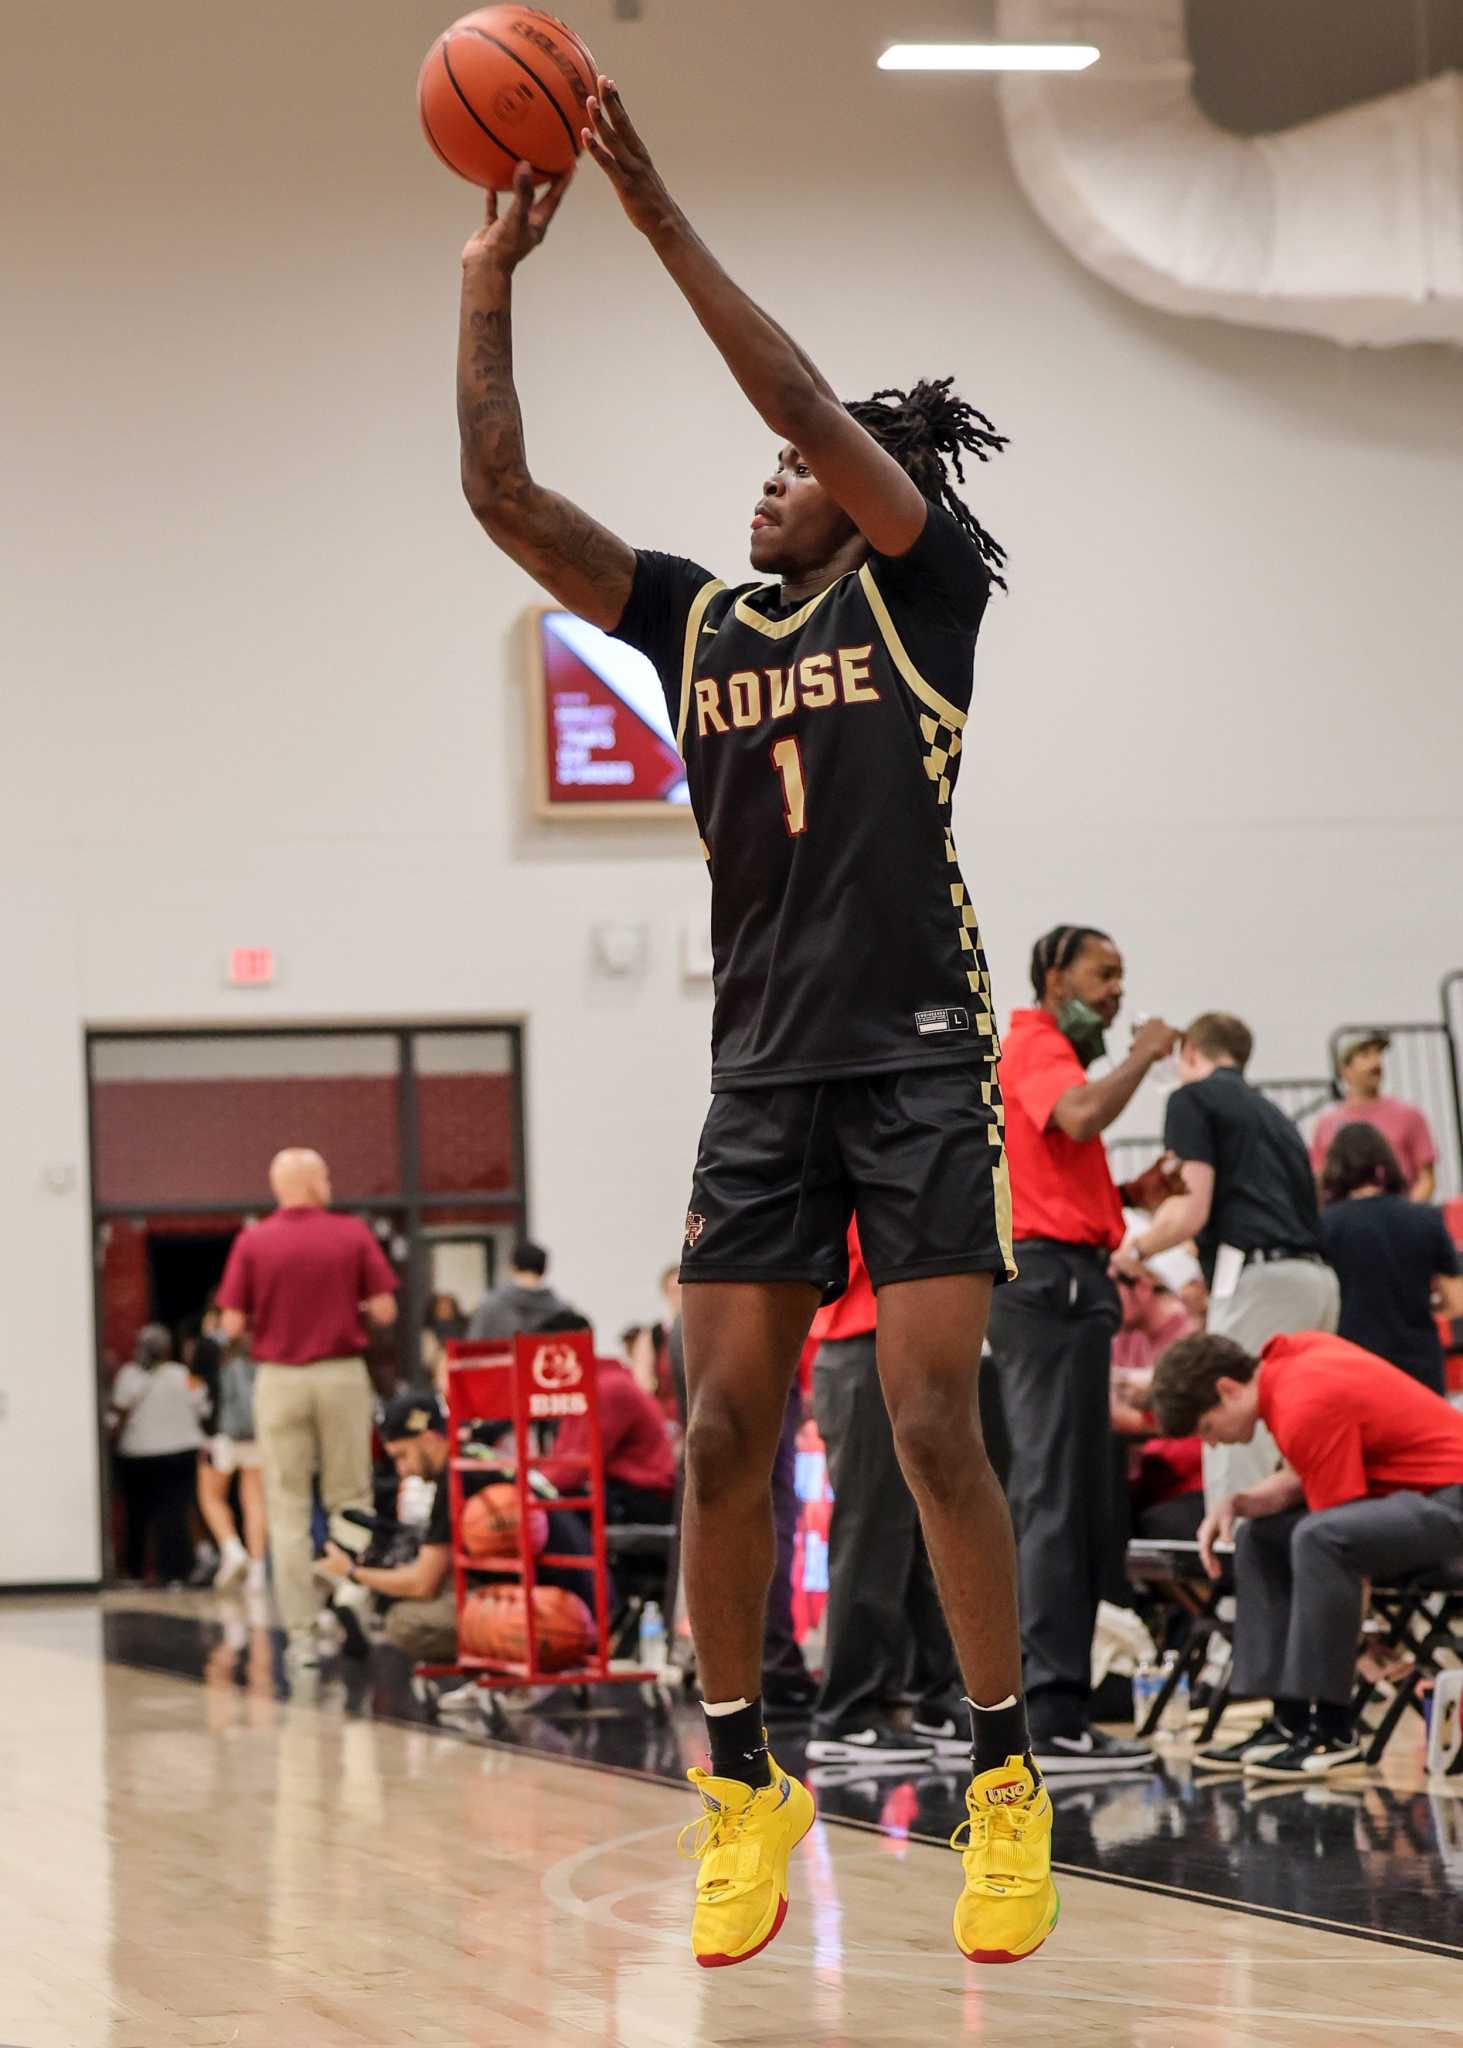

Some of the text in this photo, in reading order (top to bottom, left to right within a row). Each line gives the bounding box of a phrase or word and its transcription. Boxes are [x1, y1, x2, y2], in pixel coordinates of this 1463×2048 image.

[693, 643, 882, 737] ROUSE
[771, 736, 807, 837] 1
[953, 1013, 963, 1025] L
[984, 1782, 1026, 1806] UNO
